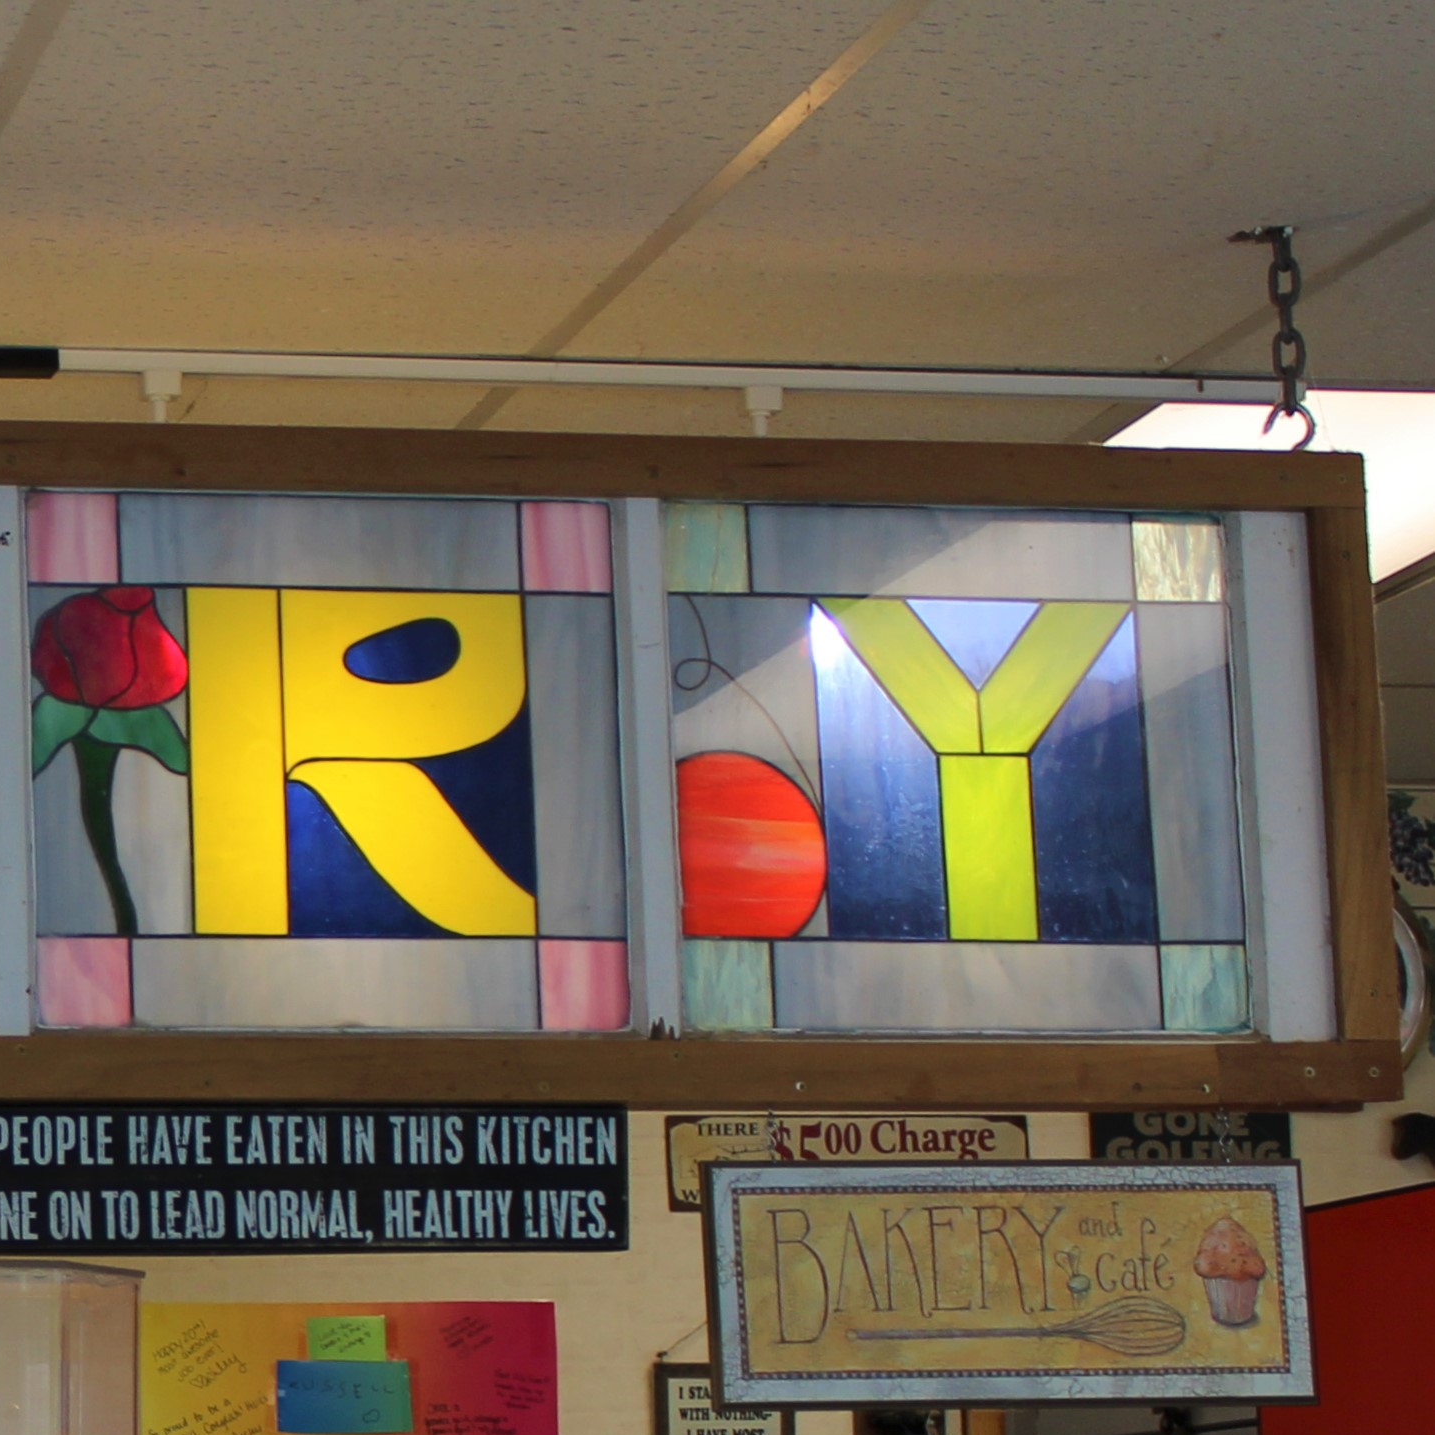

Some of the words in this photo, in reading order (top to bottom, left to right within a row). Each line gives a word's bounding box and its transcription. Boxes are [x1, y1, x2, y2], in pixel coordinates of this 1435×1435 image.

[129, 1115, 212, 1165] HAVE
[226, 1115, 328, 1165] EATEN
[342, 1115, 375, 1165] IN
[389, 1115, 464, 1165] THIS
[478, 1115, 618, 1166] KITCHEN
[697, 1122, 759, 1137] THERE
[870, 1119, 997, 1160] Charge
[1133, 1112, 1250, 1138] GONE
[1105, 1139, 1282, 1159] GOLFING
[48, 1190, 92, 1241] ON
[102, 1190, 140, 1240] TO
[150, 1190, 226, 1240] LEAD
[235, 1189, 374, 1244] NORMAL,
[383, 1189, 513, 1239] HEALTHY
[524, 1189, 616, 1239] LIVES.
[1078, 1202, 1122, 1240] and
[1095, 1218, 1176, 1293] café
[765, 1205, 1065, 1345] BAKERY
[679, 1387, 683, 1399] I
[679, 1408, 710, 1420] WITH
